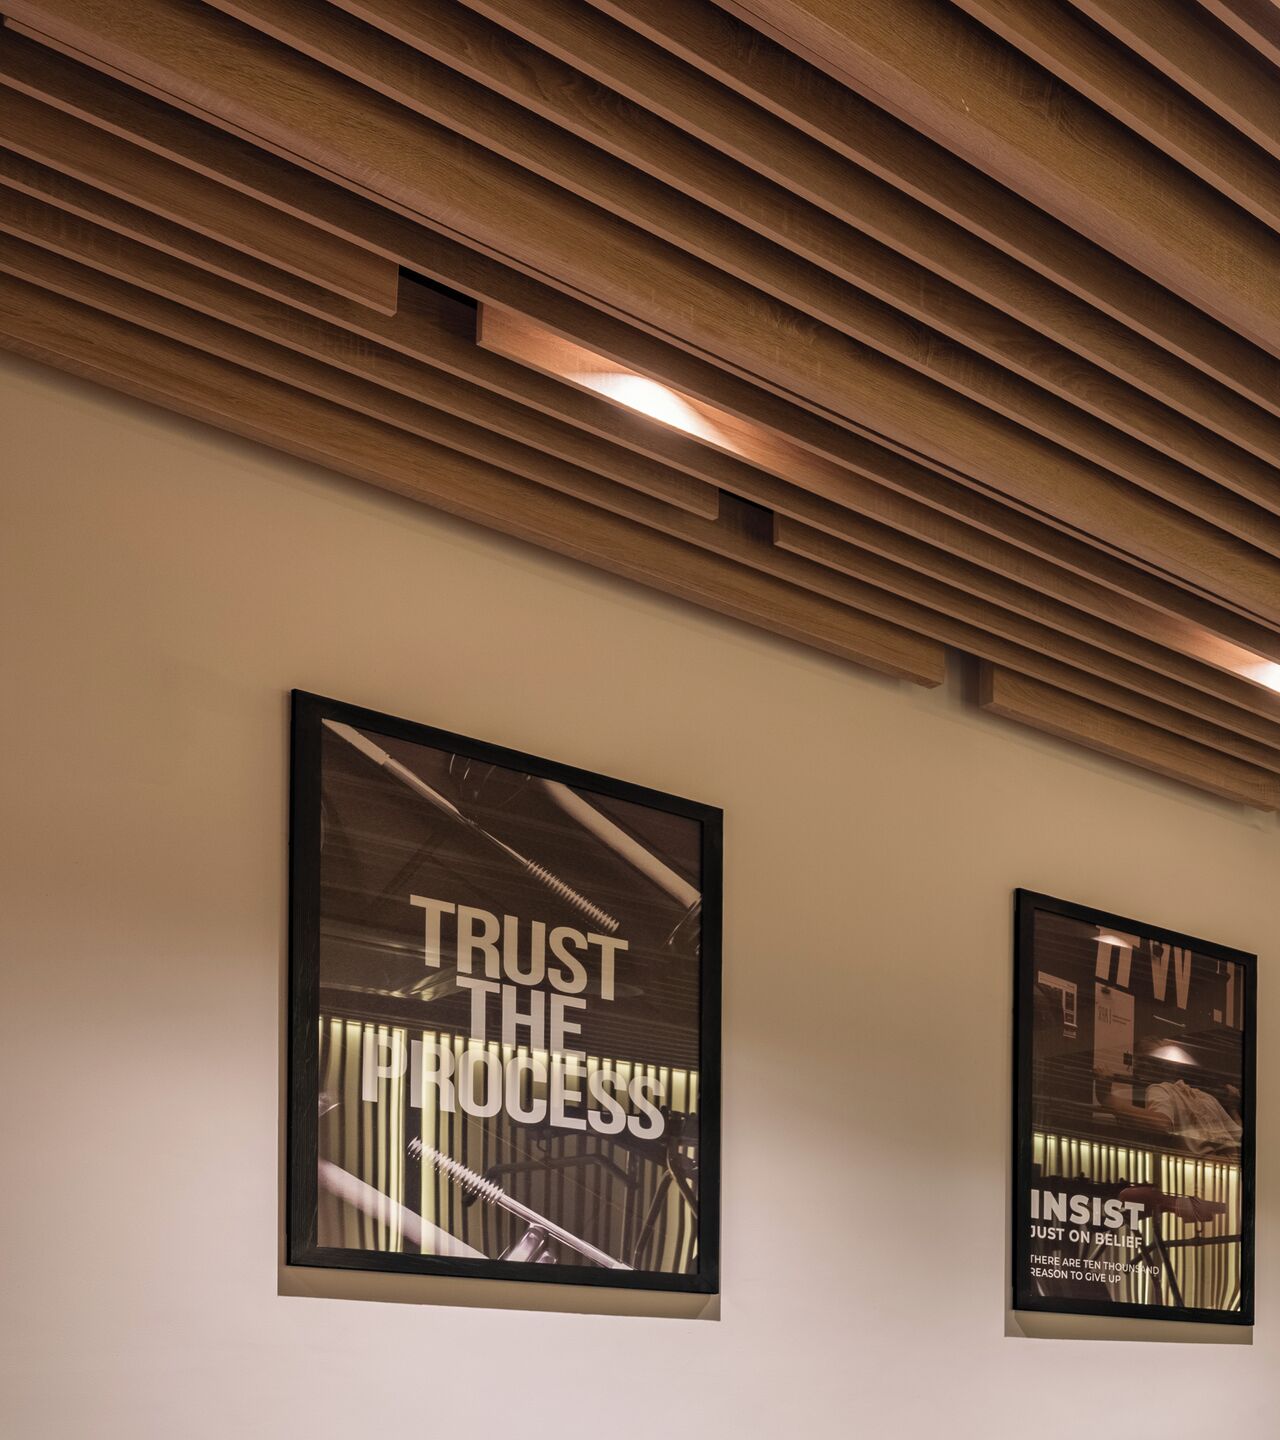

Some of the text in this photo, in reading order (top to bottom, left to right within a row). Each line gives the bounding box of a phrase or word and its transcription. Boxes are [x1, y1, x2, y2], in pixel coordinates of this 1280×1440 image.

[410, 894, 629, 1001] TRUST
[456, 975, 587, 1062] THE
[362, 1031, 665, 1140] PROCESS
[1030, 1188, 1145, 1231] INSIST
[1030, 1225, 1142, 1250] JUST ON BELIEF
[1062, 1258, 1081, 1268] ARE
[1083, 1259, 1101, 1270] TEN
[1070, 1270, 1083, 1281] TO
[1085, 1273, 1107, 1283] GIVE
